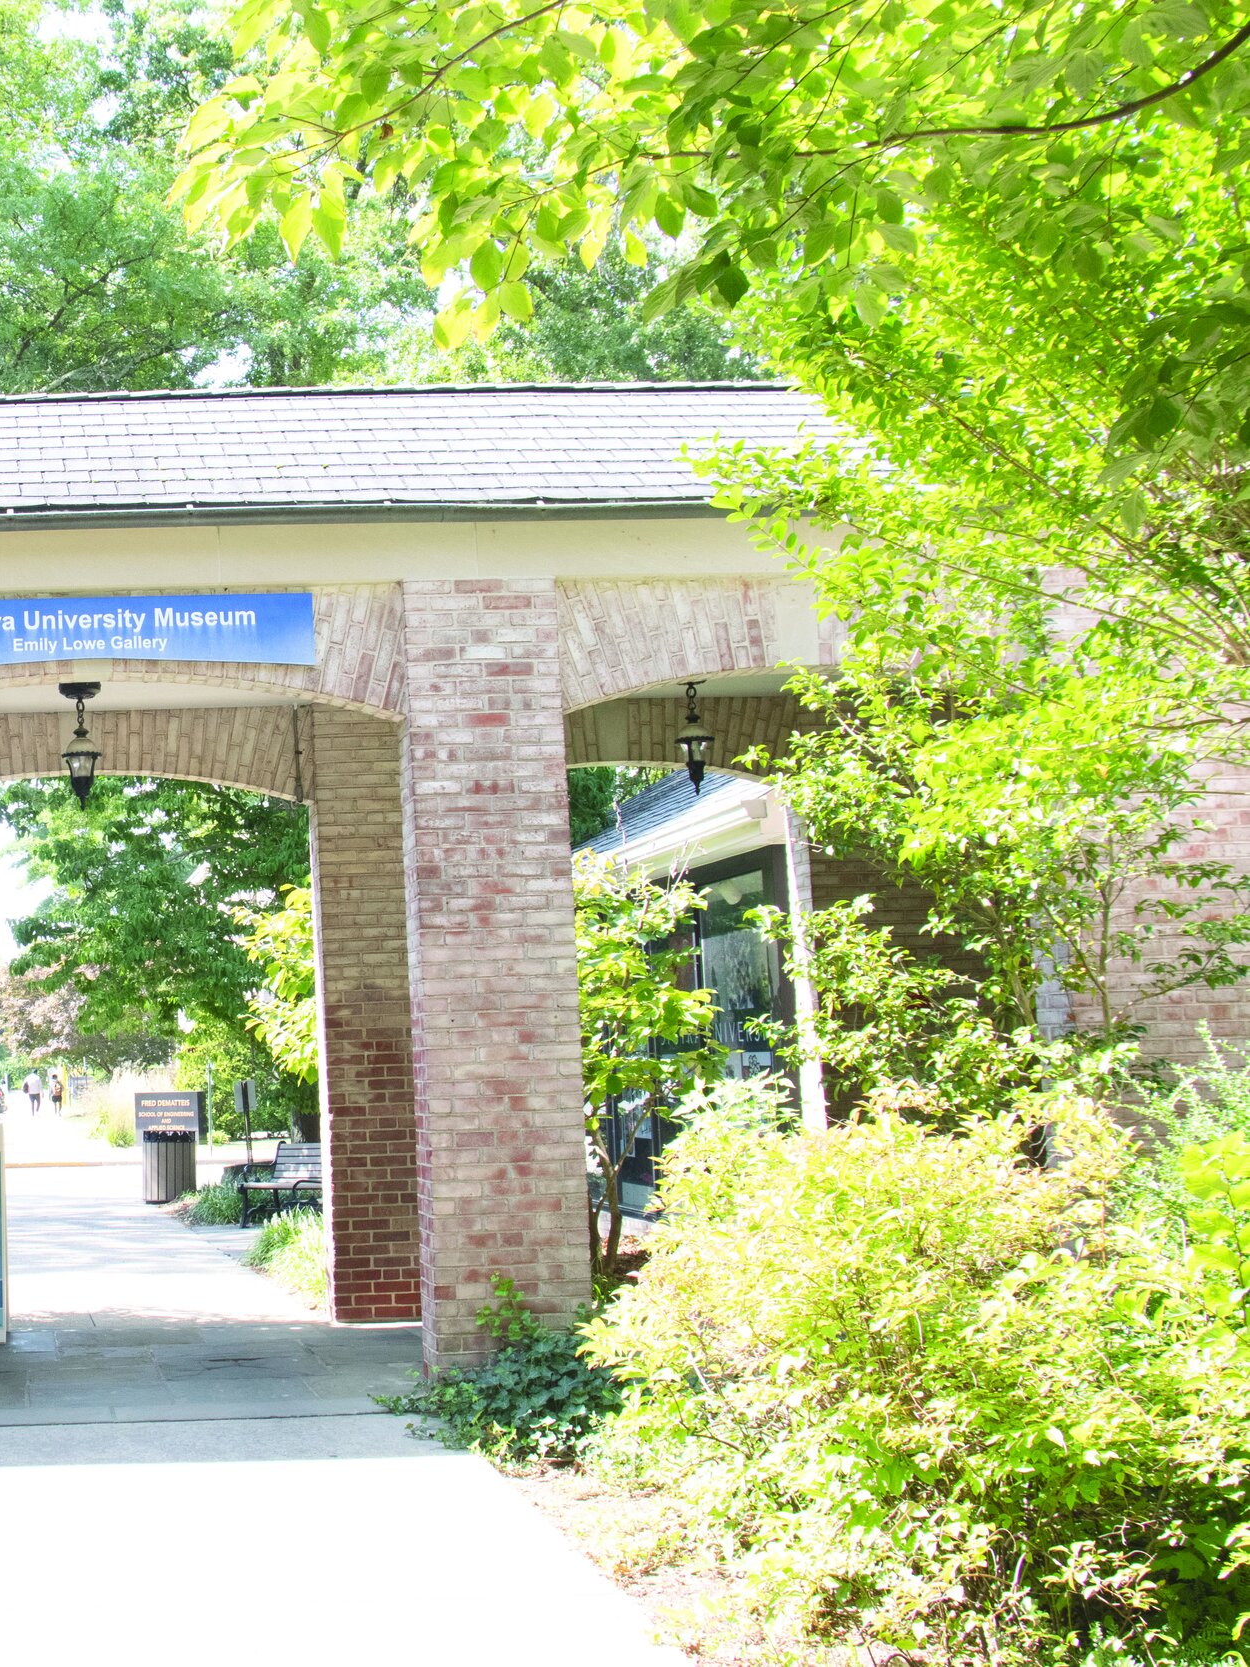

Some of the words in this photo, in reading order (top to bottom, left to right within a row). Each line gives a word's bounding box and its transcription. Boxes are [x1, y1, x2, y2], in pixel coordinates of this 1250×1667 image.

[23, 608, 147, 632] University
[154, 606, 257, 627] Museum
[12, 637, 57, 653] Emily
[62, 637, 106, 651] Lowe
[110, 635, 168, 651] Gallery
